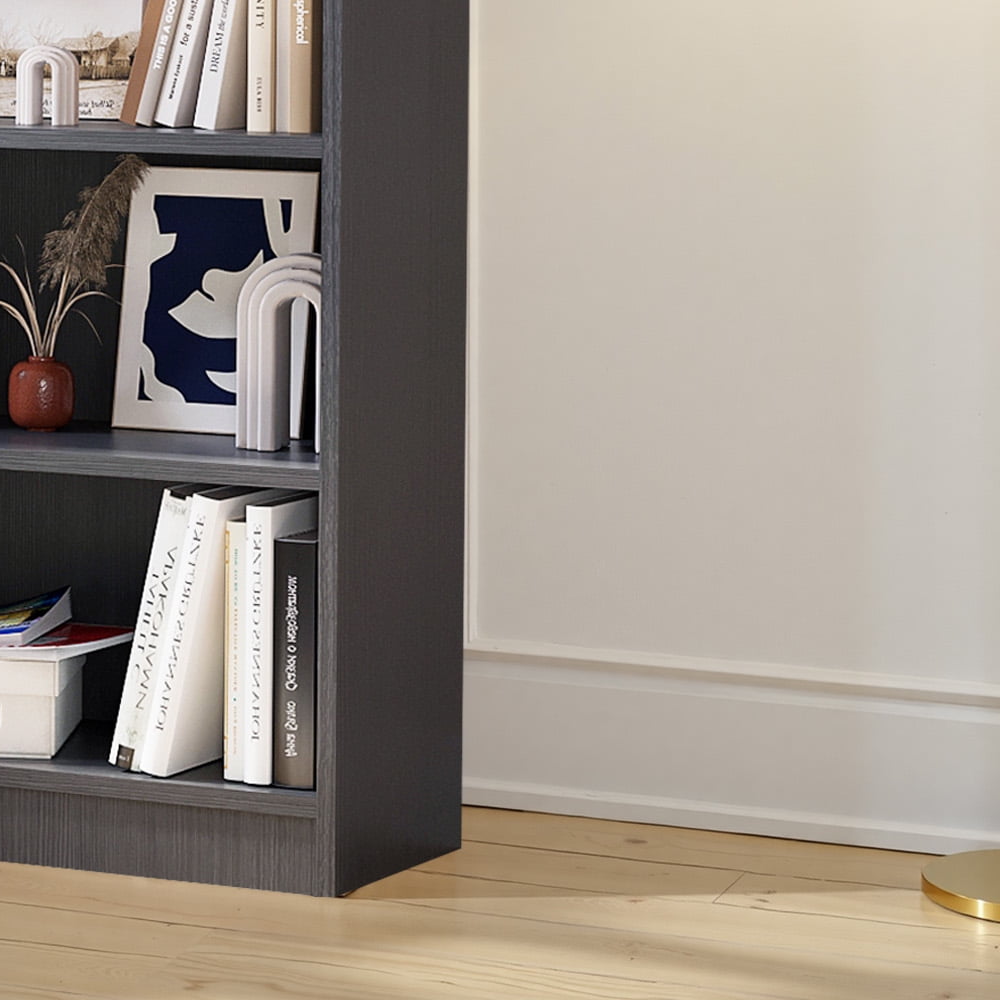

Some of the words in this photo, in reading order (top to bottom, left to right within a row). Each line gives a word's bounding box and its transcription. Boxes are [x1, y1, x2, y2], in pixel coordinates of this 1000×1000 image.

[162, 23, 171, 33] A
[292, 0, 309, 45] spherical
[159, 35, 169, 46] IS
[180, 33, 190, 46] for
[186, 23, 193, 31] a
[210, 32, 225, 73] DREAM
[218, 18, 226, 30] the
[153, 47, 165, 70] THIS
